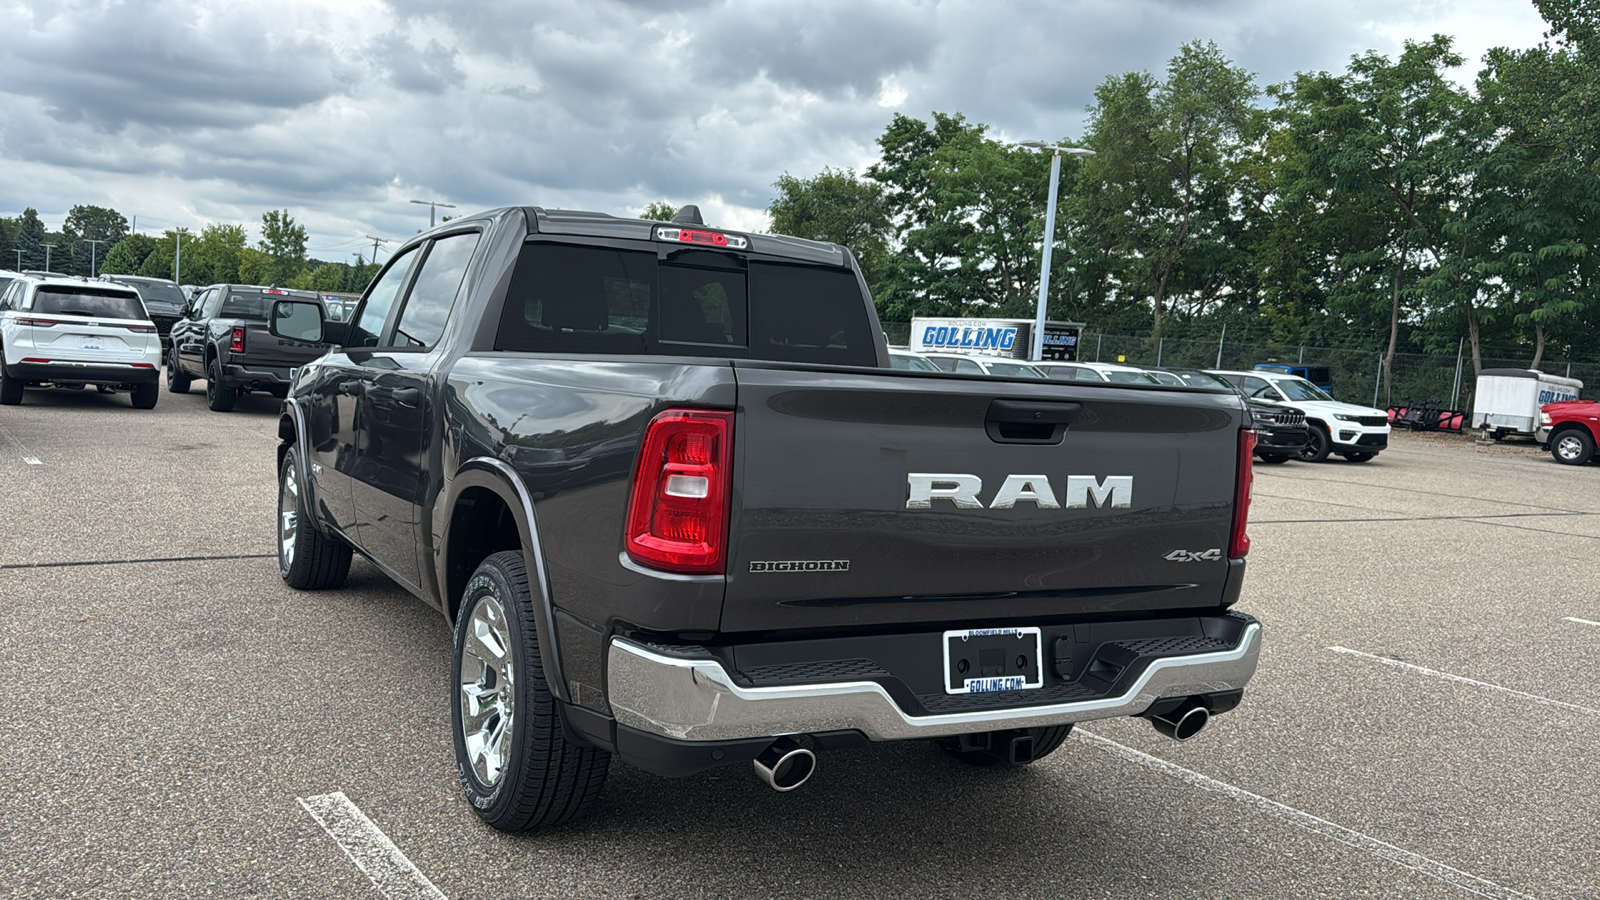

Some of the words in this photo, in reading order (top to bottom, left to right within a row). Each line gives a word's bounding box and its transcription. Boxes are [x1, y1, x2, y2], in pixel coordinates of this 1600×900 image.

[922, 326, 1018, 350] GOLLING
[1043, 335, 1077, 346] OLLING
[905, 472, 1134, 509] RAM
[749, 560, 850, 573] BIGHORN
[970, 678, 1022, 693] GOLLING.COM
